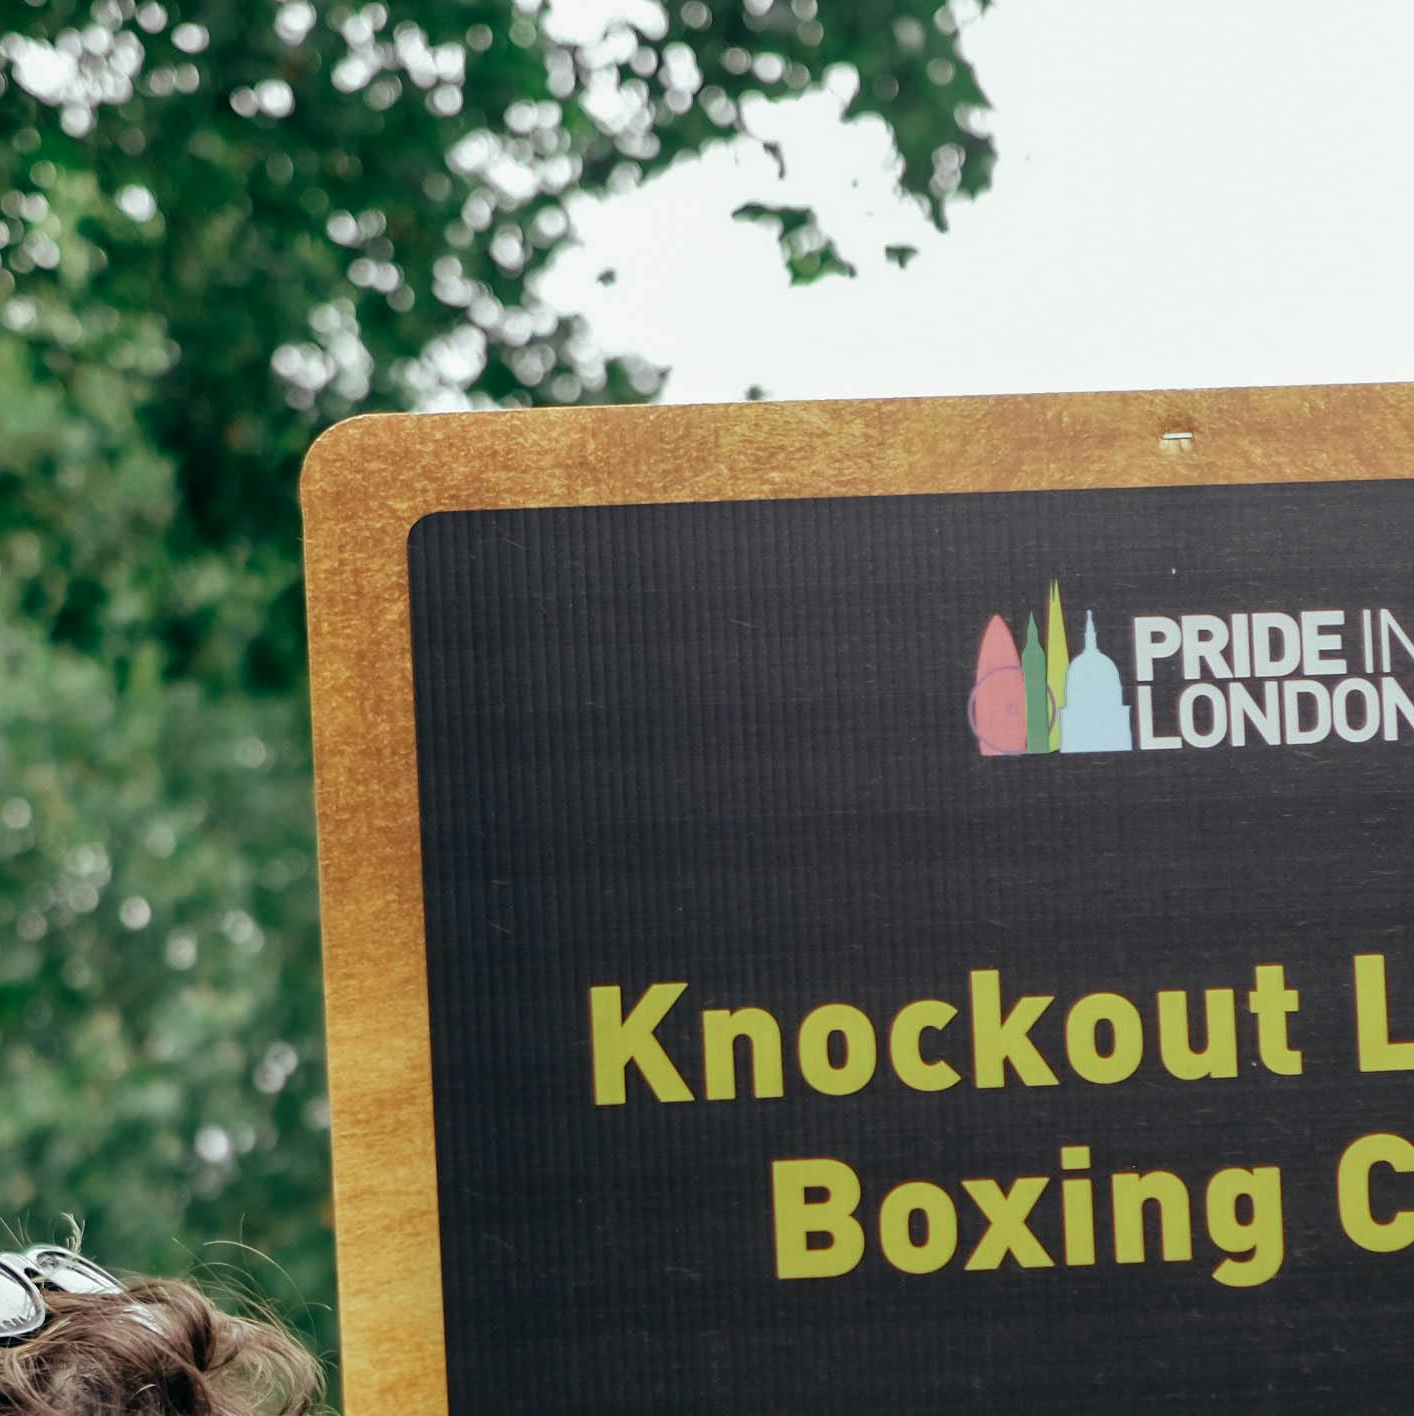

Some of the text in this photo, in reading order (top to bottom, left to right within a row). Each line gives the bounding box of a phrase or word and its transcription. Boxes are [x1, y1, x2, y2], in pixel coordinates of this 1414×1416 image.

[1133, 609, 1348, 682] PRIDE
[588, 963, 1304, 1106] Knockout
[771, 1145, 1285, 1288] Boxing
